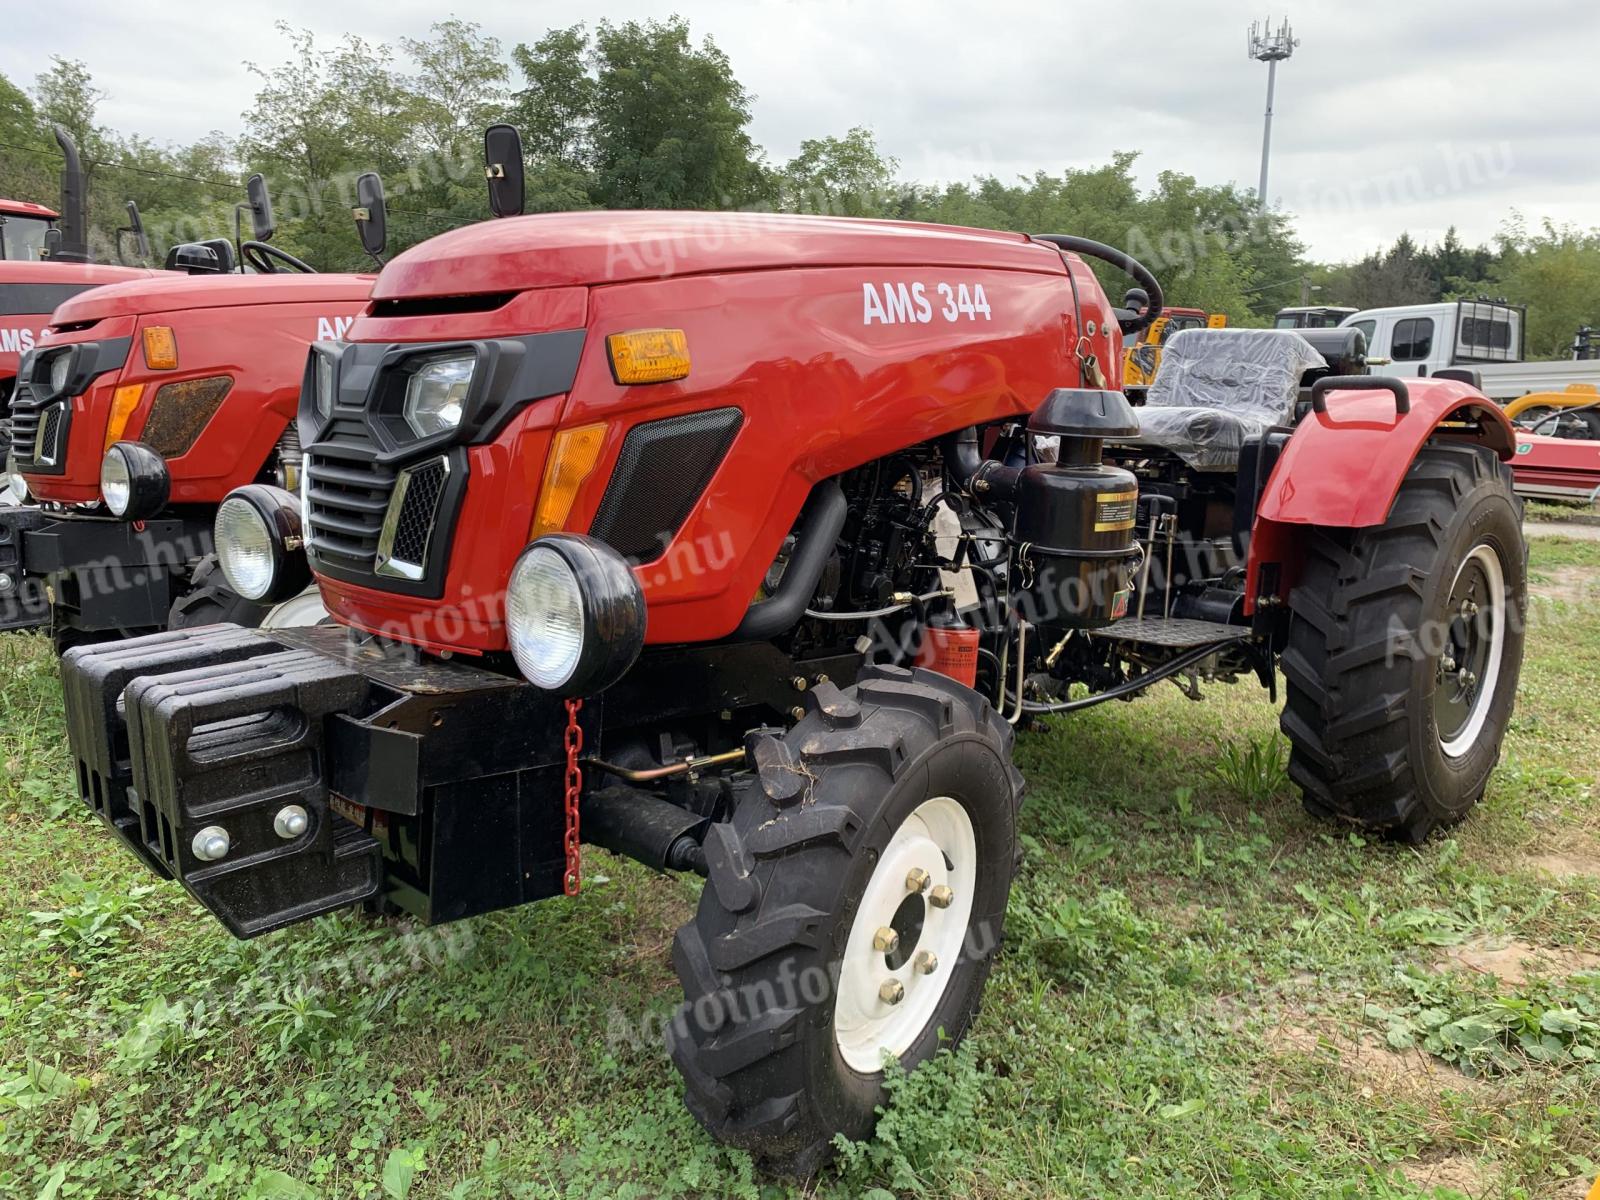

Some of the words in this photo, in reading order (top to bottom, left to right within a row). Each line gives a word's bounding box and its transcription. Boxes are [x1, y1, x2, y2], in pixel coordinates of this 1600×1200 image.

[862, 281, 933, 325] AMS
[937, 282, 992, 321] 344
[0, 328, 35, 352] MS
